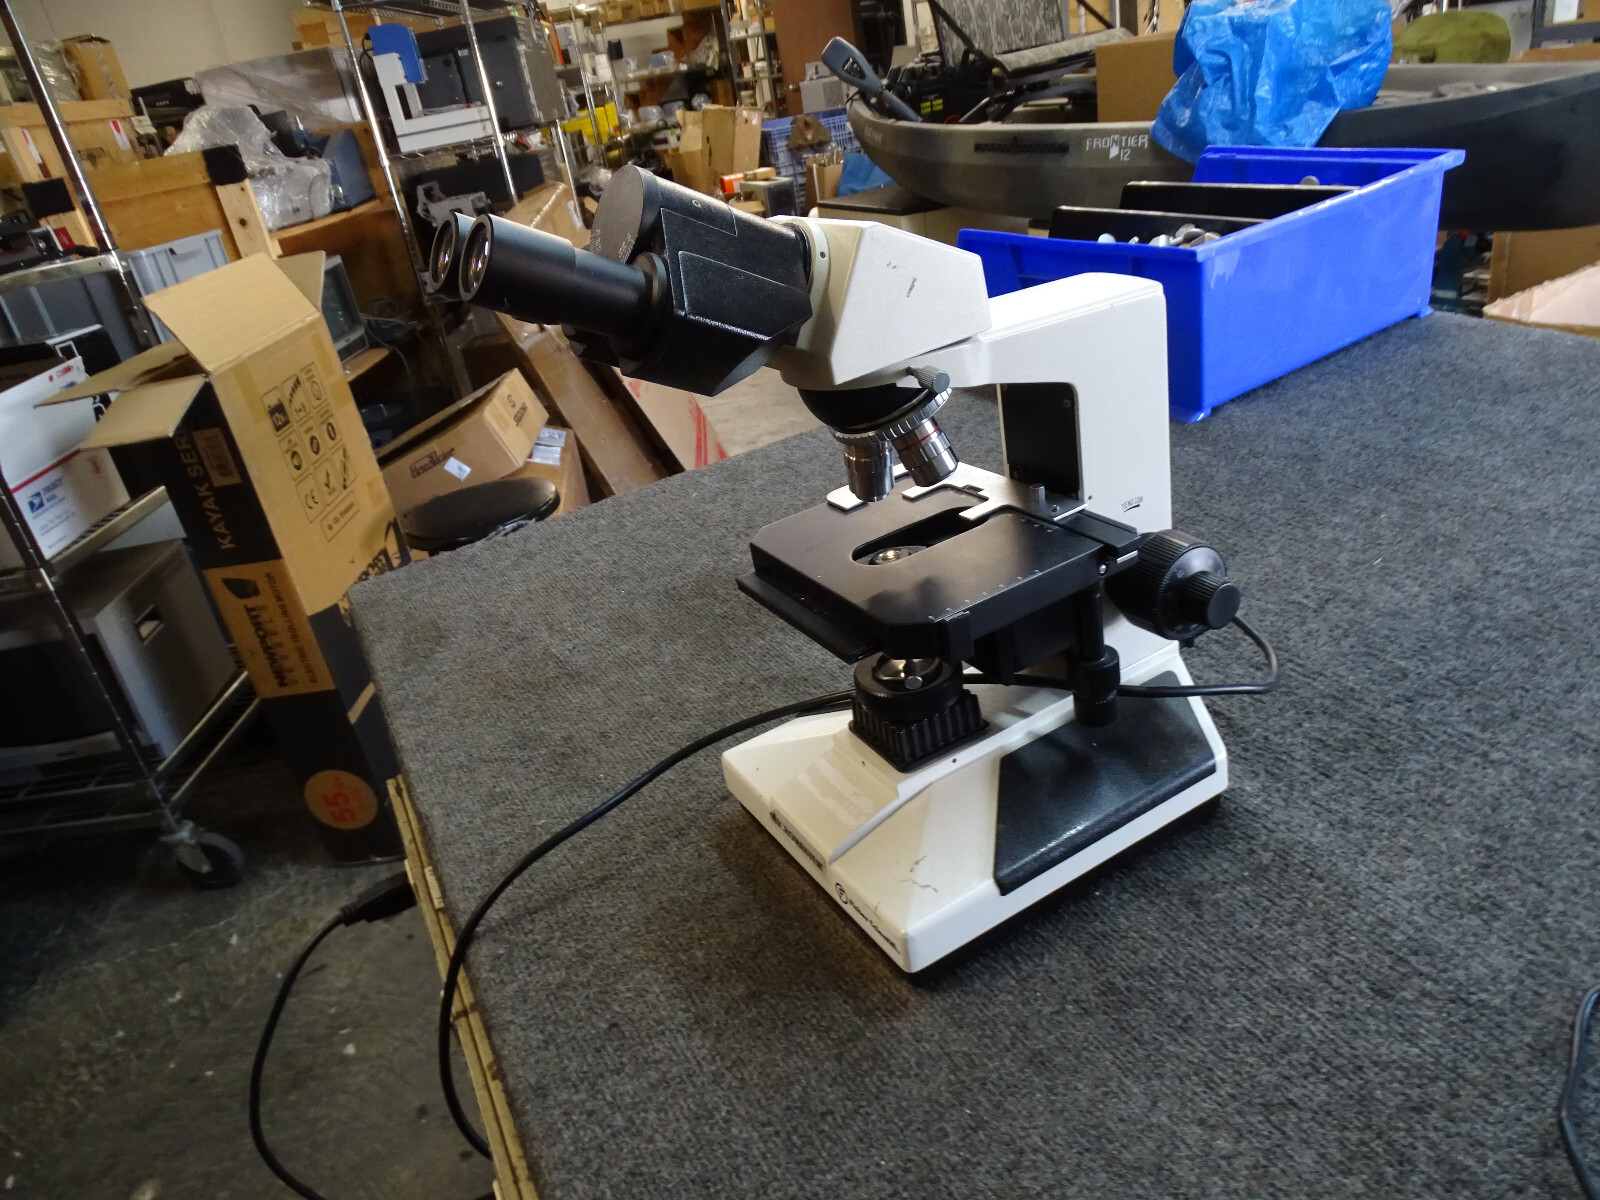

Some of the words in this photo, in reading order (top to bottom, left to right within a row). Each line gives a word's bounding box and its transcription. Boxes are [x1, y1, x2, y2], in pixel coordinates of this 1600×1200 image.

[1086, 134, 1148, 156] FRONTIER
[1120, 148, 1131, 161] 12
[194, 481, 236, 550] KAYAK
[264, 572, 282, 602] MOTOR
[243, 604, 288, 687] NEWPORT
[322, 791, 356, 822] 55
